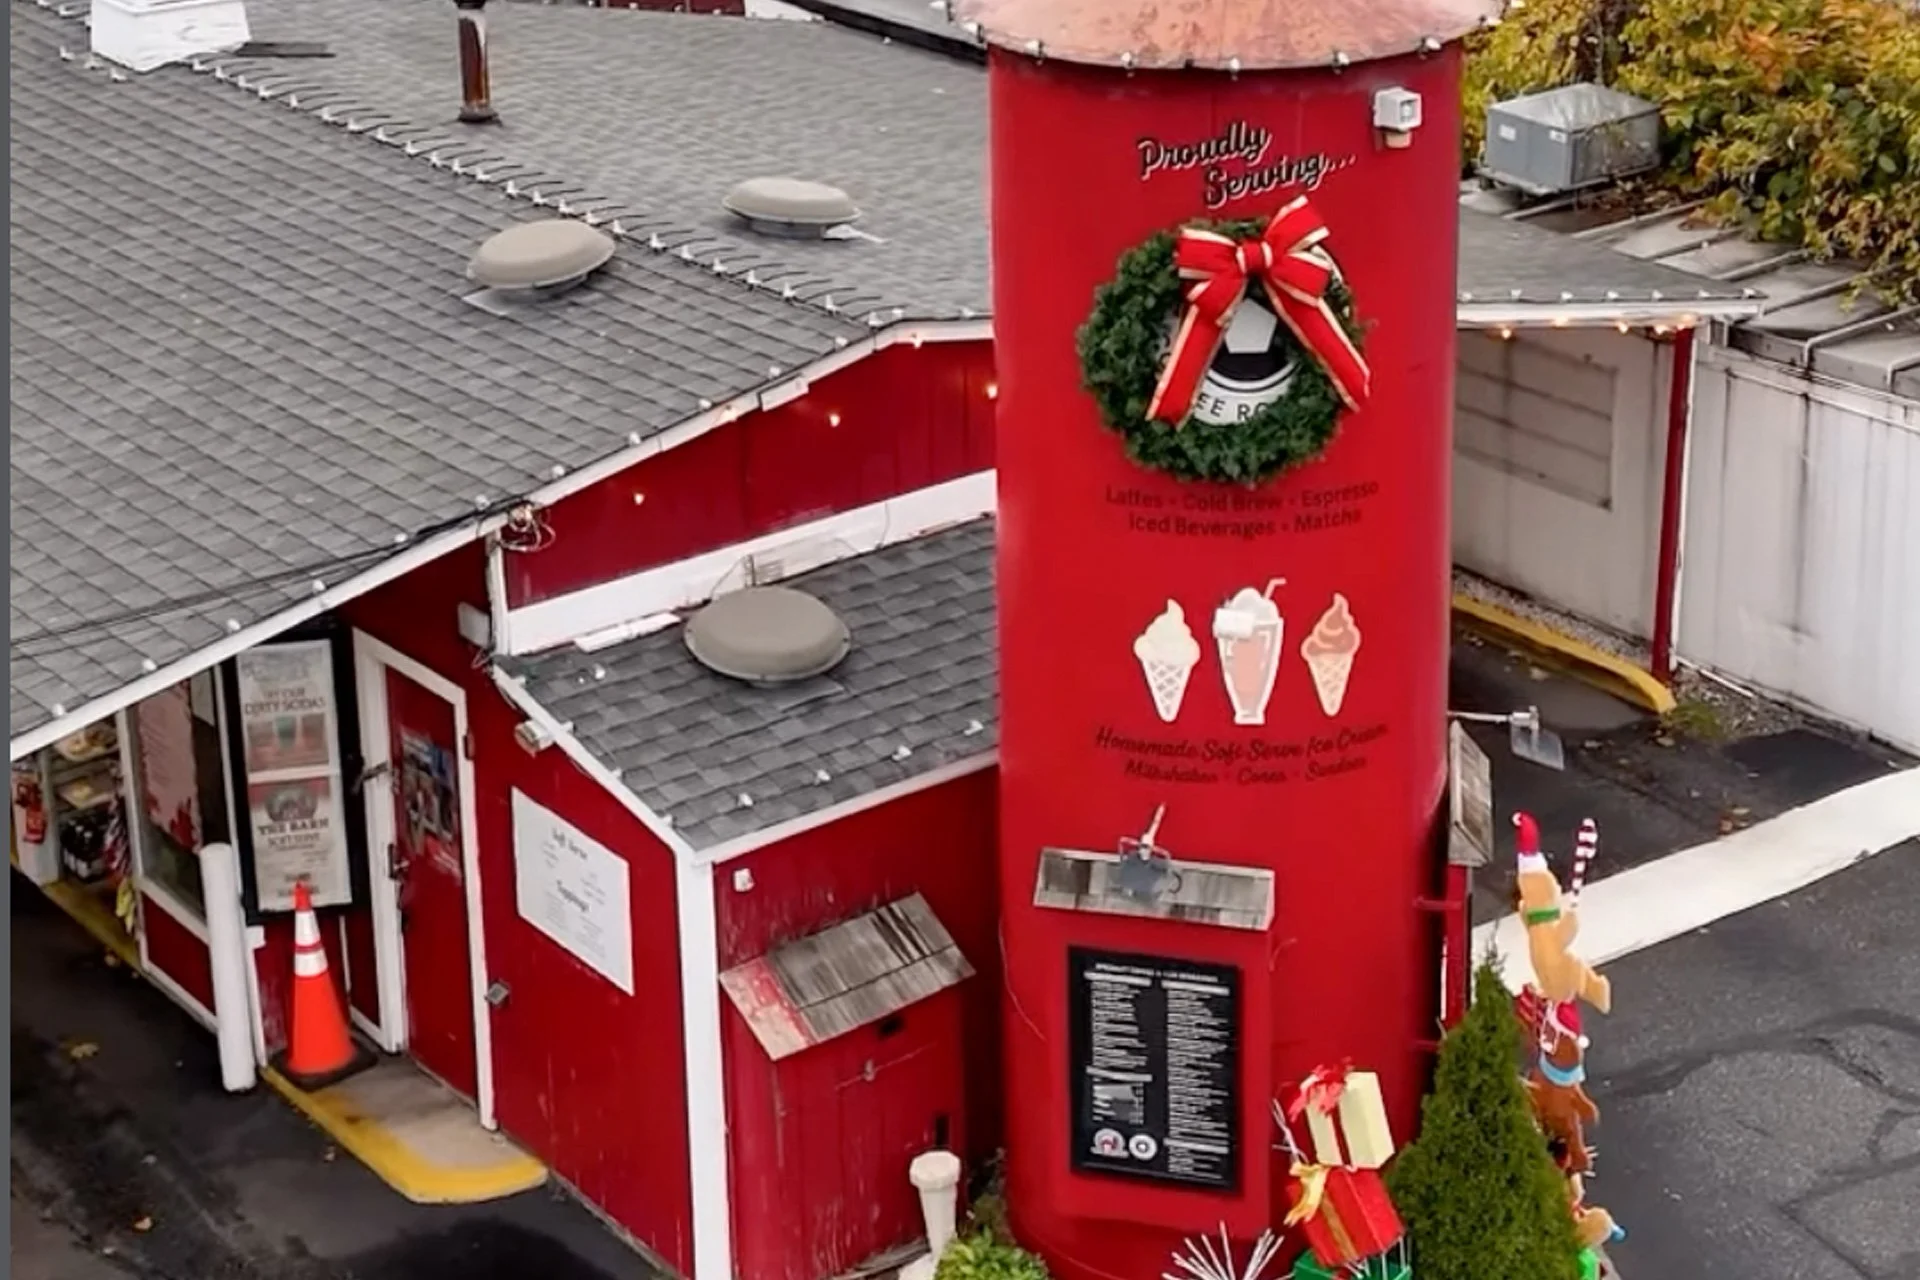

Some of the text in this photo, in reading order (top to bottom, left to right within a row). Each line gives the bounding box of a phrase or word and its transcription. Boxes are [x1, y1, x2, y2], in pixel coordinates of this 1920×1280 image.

[1137, 120, 1273, 181] Proudly
[1205, 153, 1356, 210] Serving...
[1106, 485, 1162, 509] Lattes
[1184, 491, 1227, 512] Cold
[1301, 479, 1380, 510] Espresso
[1129, 507, 1363, 541] Iced Beverages Matcha
[1095, 724, 1199, 758] Homemade
[1201, 737, 1244, 765] Soft
[1249, 736, 1305, 761] Serve
[1306, 734, 1334, 758] Ice
